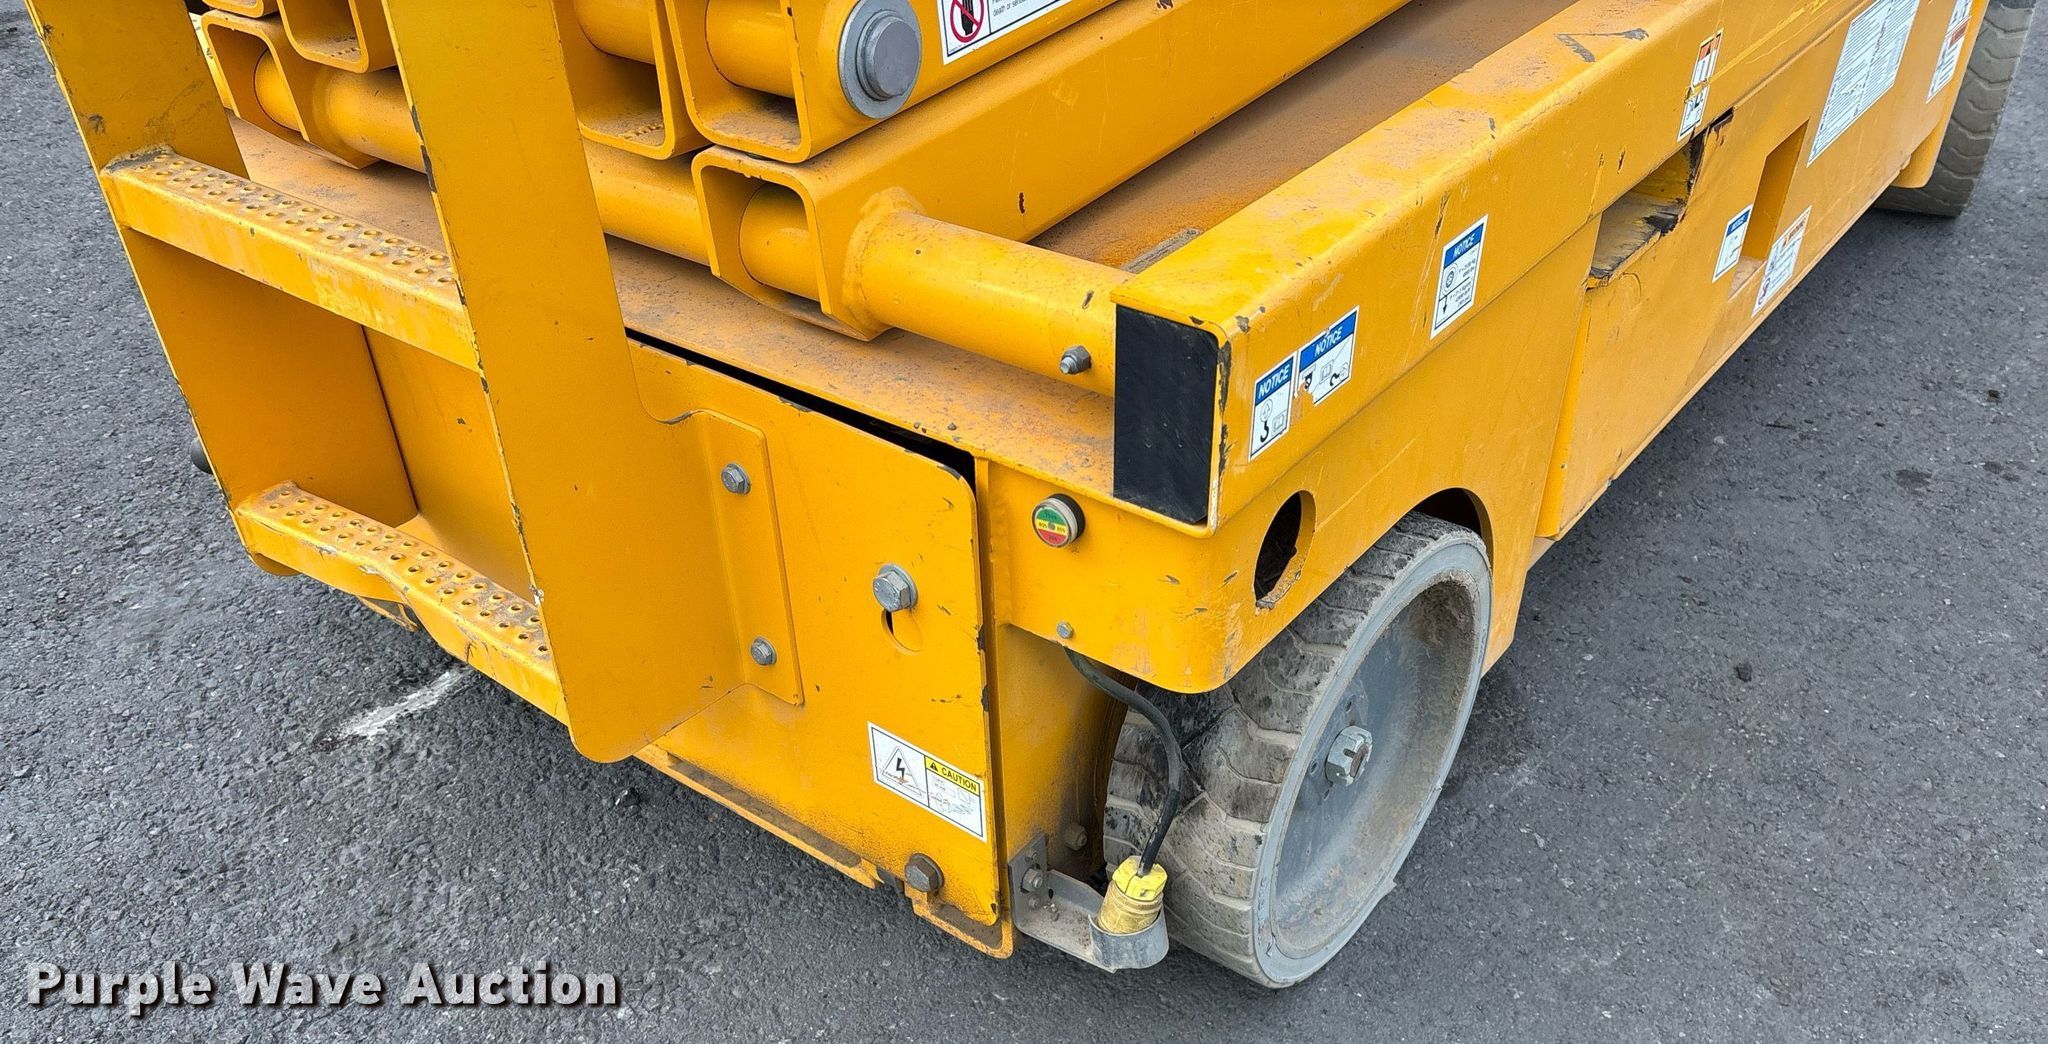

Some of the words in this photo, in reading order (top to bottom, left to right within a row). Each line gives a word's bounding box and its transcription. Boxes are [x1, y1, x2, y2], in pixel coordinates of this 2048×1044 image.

[1314, 326, 1344, 357] NOTICE
[1258, 364, 1290, 399] NOTICE
[941, 766, 977, 792] CAUTION
